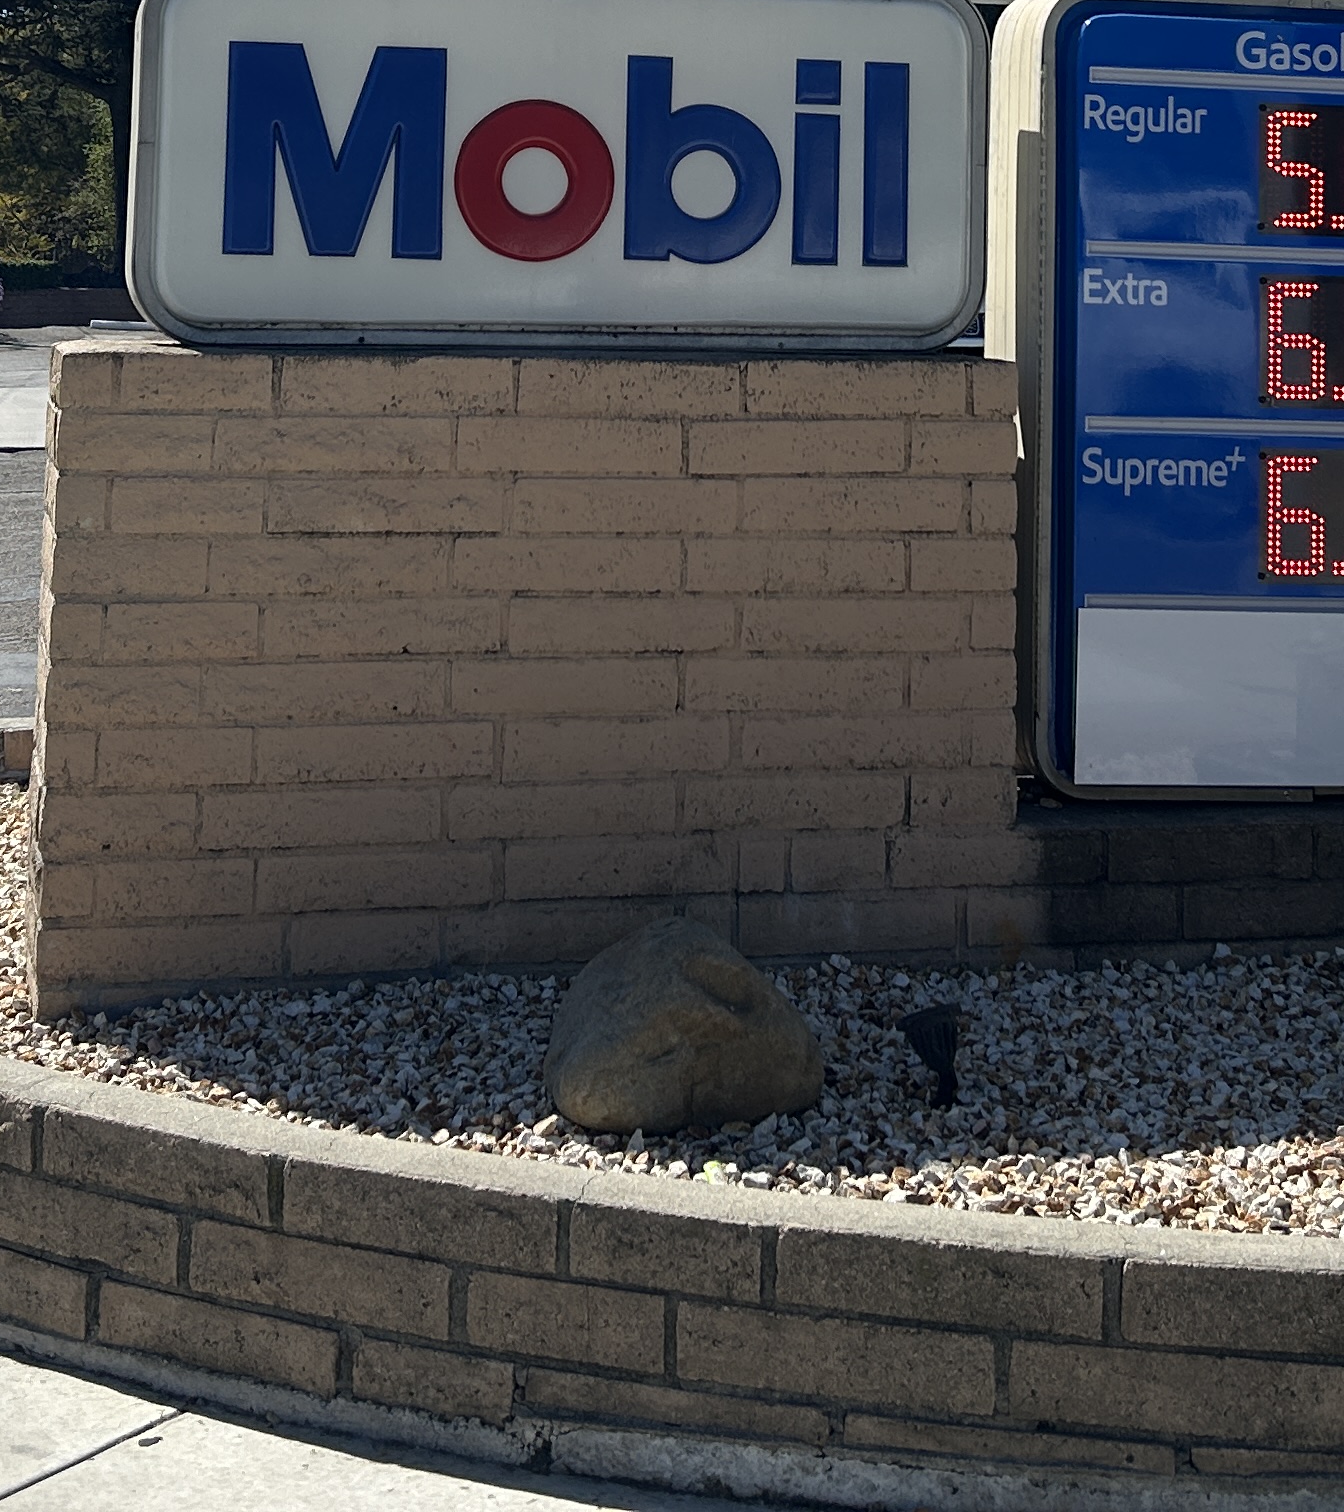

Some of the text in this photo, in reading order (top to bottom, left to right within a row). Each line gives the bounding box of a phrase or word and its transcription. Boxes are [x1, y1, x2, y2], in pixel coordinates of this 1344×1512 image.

[1082, 93, 1208, 144] Regular
[221, 40, 910, 268] Mobil
[1082, 267, 1168, 306] Extra
